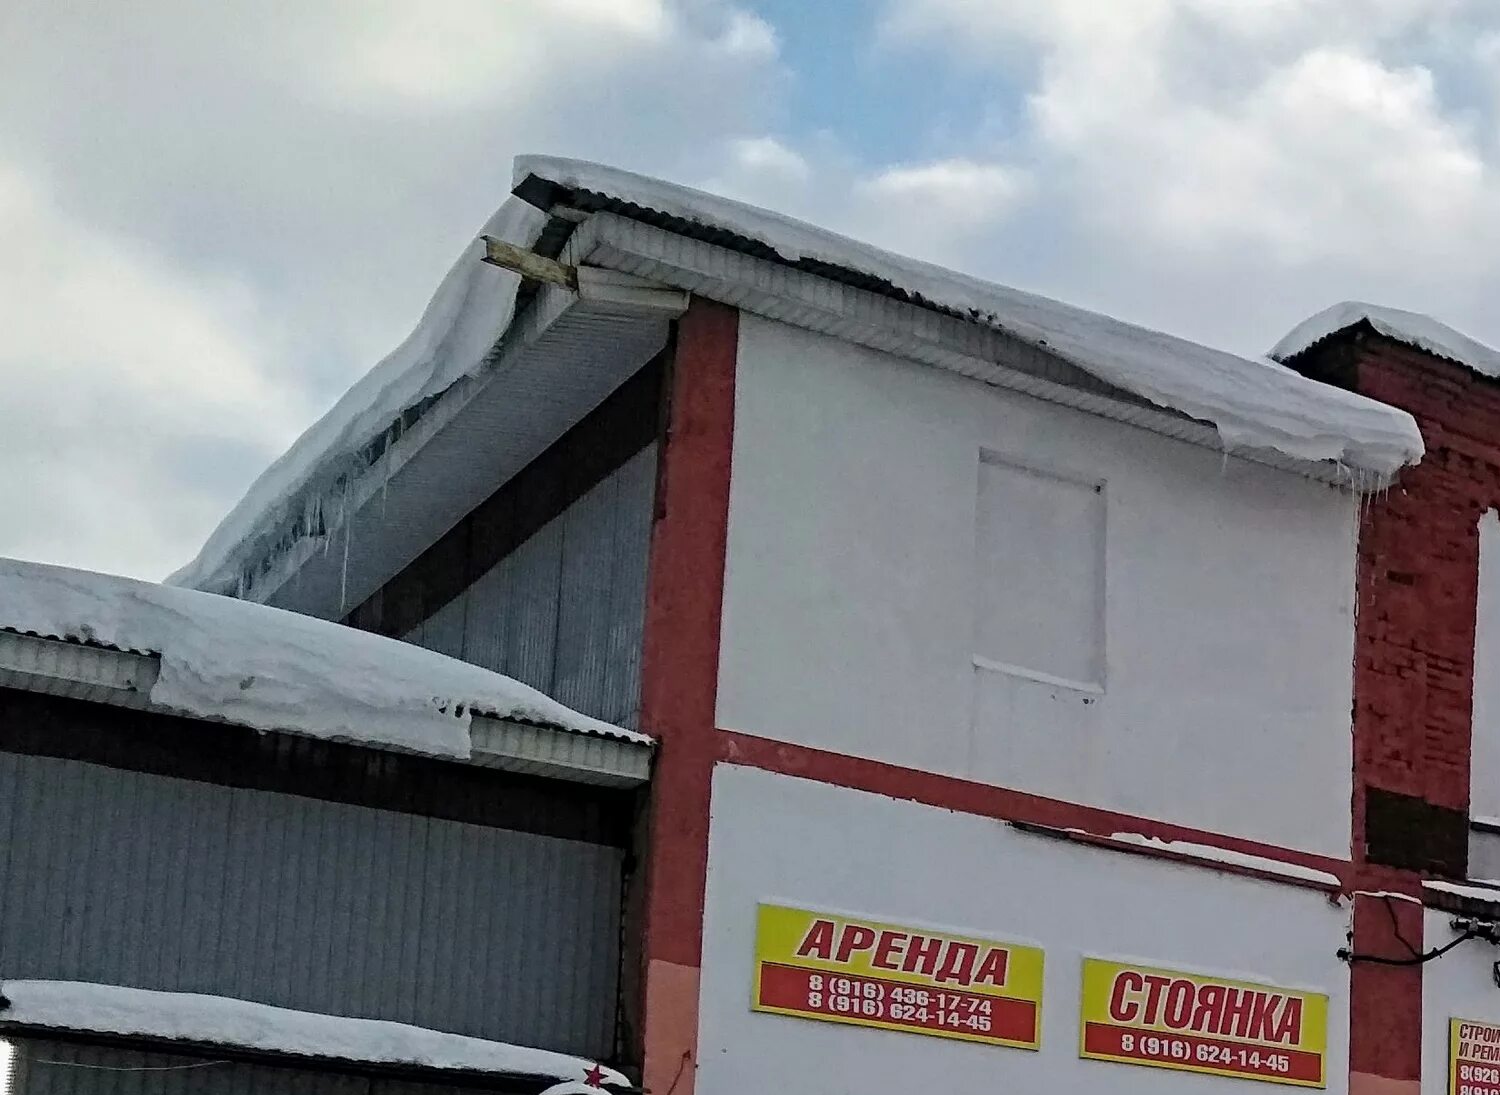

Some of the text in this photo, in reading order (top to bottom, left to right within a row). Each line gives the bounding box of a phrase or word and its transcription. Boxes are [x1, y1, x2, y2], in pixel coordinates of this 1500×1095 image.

[796, 919, 1010, 987] АРЕНДА
[807, 991, 992, 1032] 8 (916) 624-14-45
[808, 974, 992, 1016] 8 (916) 436-17-74
[1108, 970, 1304, 1046] СТОЯНКА
[1121, 1033, 1290, 1073] 8 (916) 624-14-45
[1458, 1041, 1471, 1058] И
